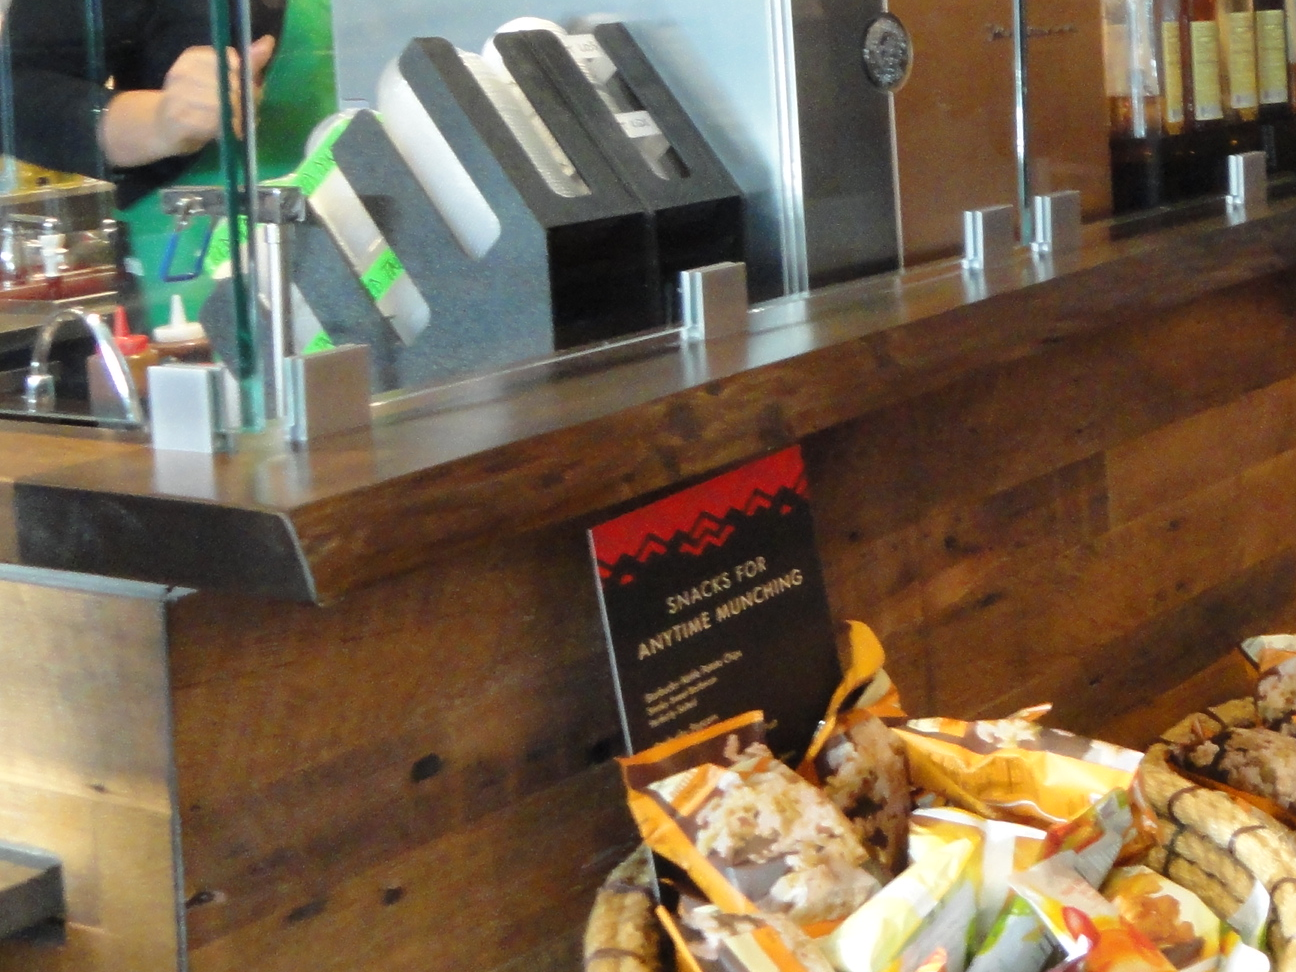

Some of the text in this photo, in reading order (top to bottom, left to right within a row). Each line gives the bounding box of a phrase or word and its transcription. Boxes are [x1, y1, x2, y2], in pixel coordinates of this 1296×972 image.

[637, 568, 803, 660] ANYTIME MUNCHING
[666, 556, 766, 614] SNACKS FOR
